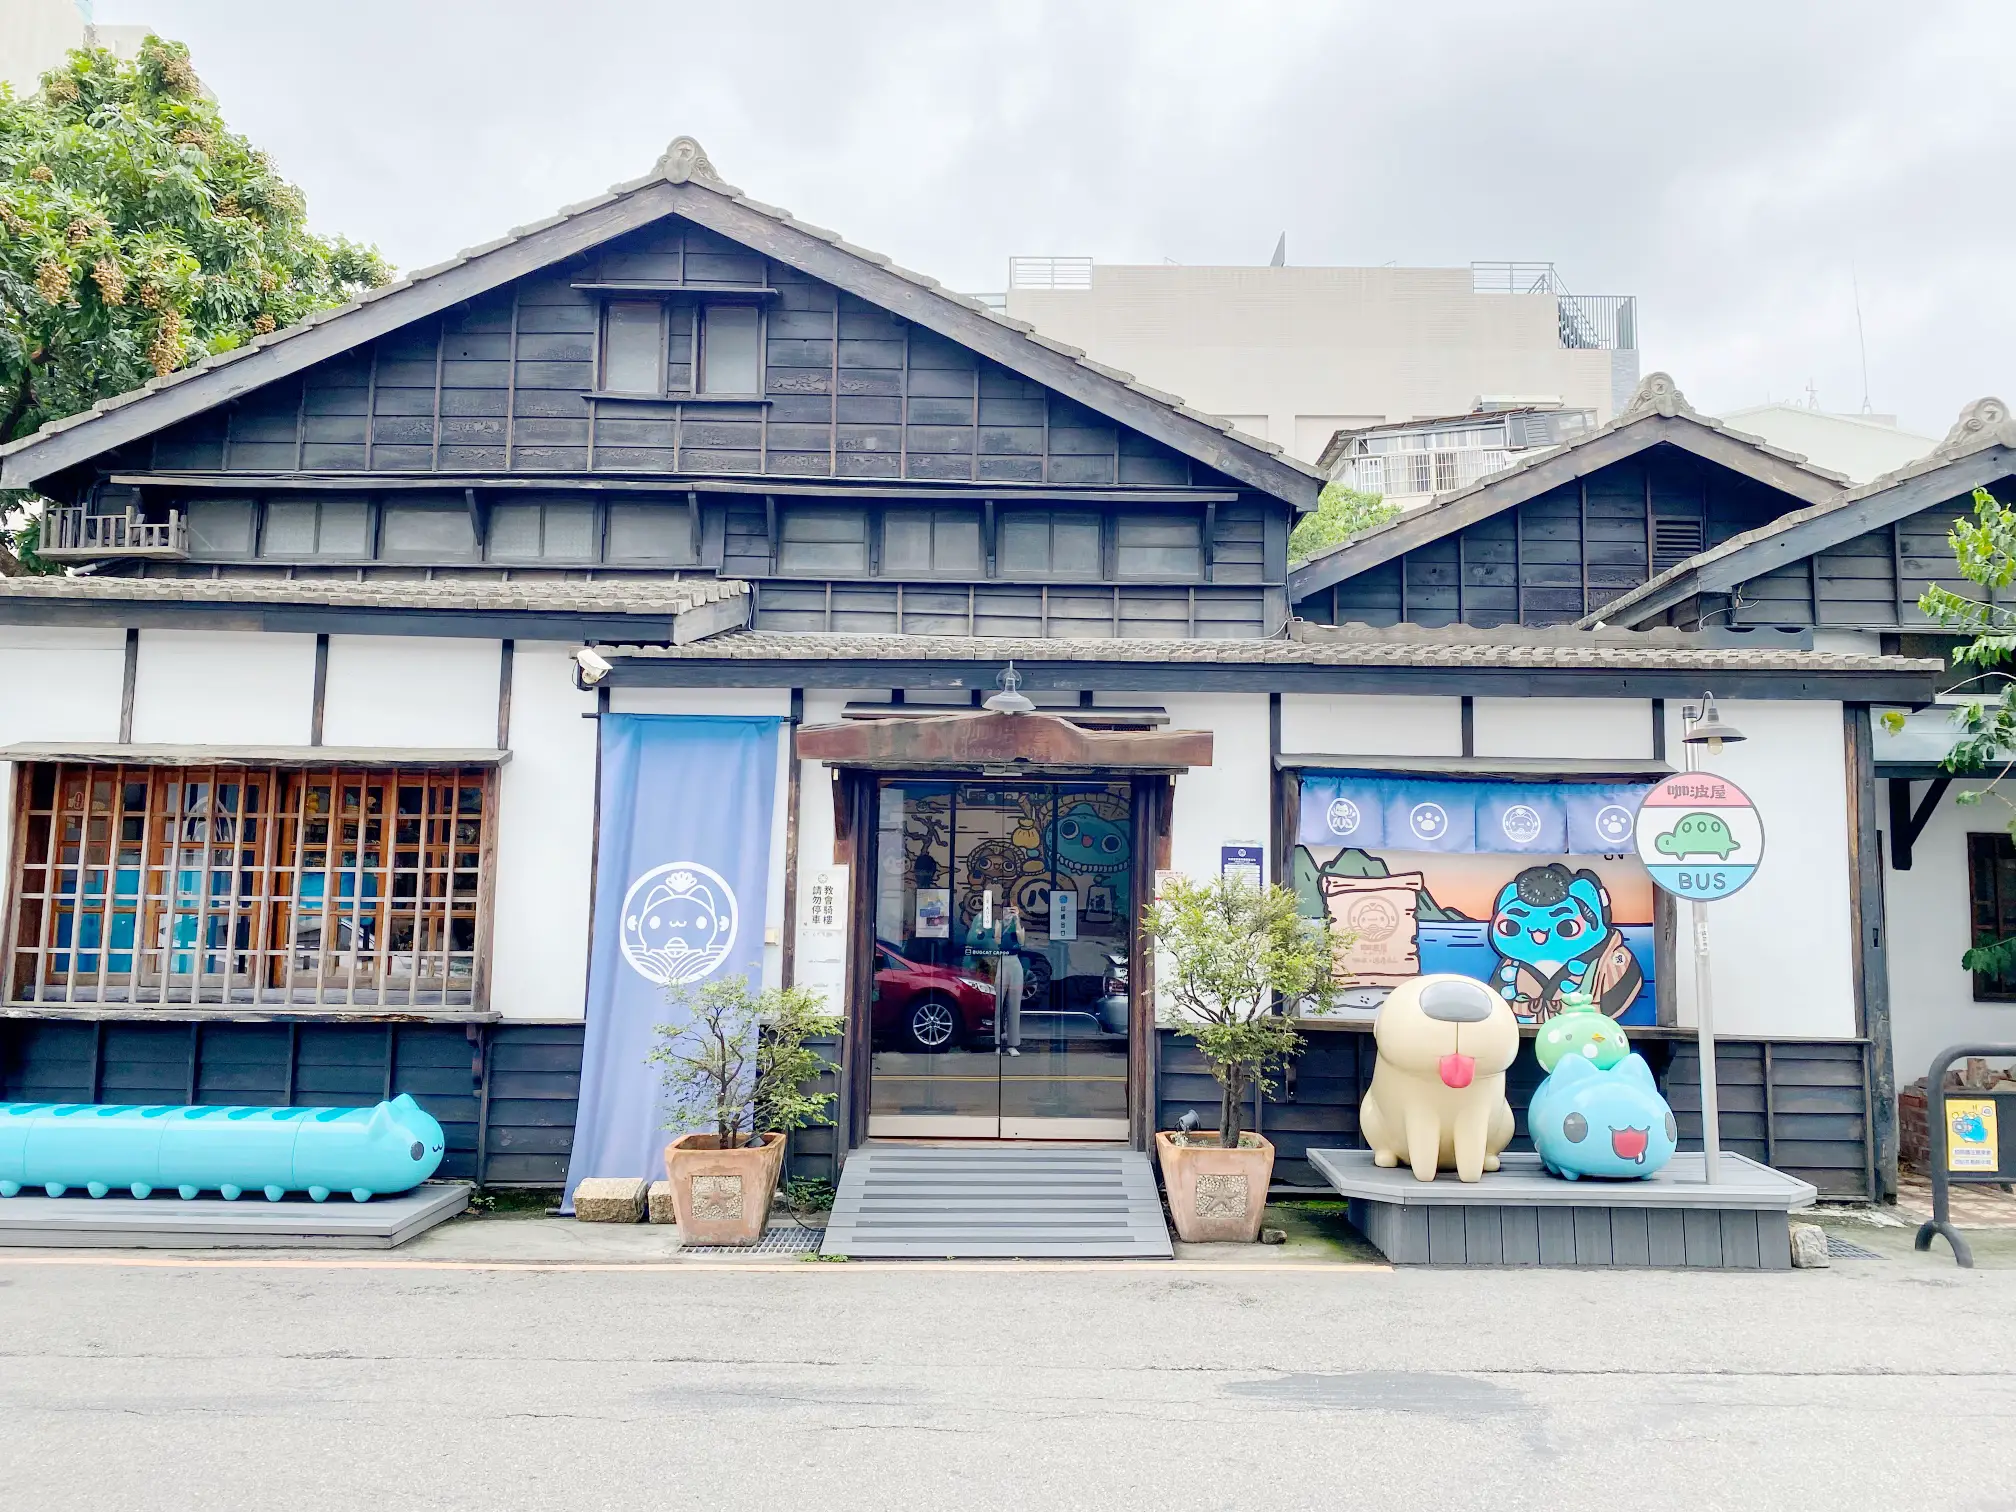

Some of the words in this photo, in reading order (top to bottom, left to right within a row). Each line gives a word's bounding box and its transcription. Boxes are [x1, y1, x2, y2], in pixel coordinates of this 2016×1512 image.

[1667, 785, 1727, 799] 咖波屋
[1678, 872, 1726, 891] BUS
[812, 885, 822, 925] 請勿停車
[823, 885, 834, 925] 教會騎樓
